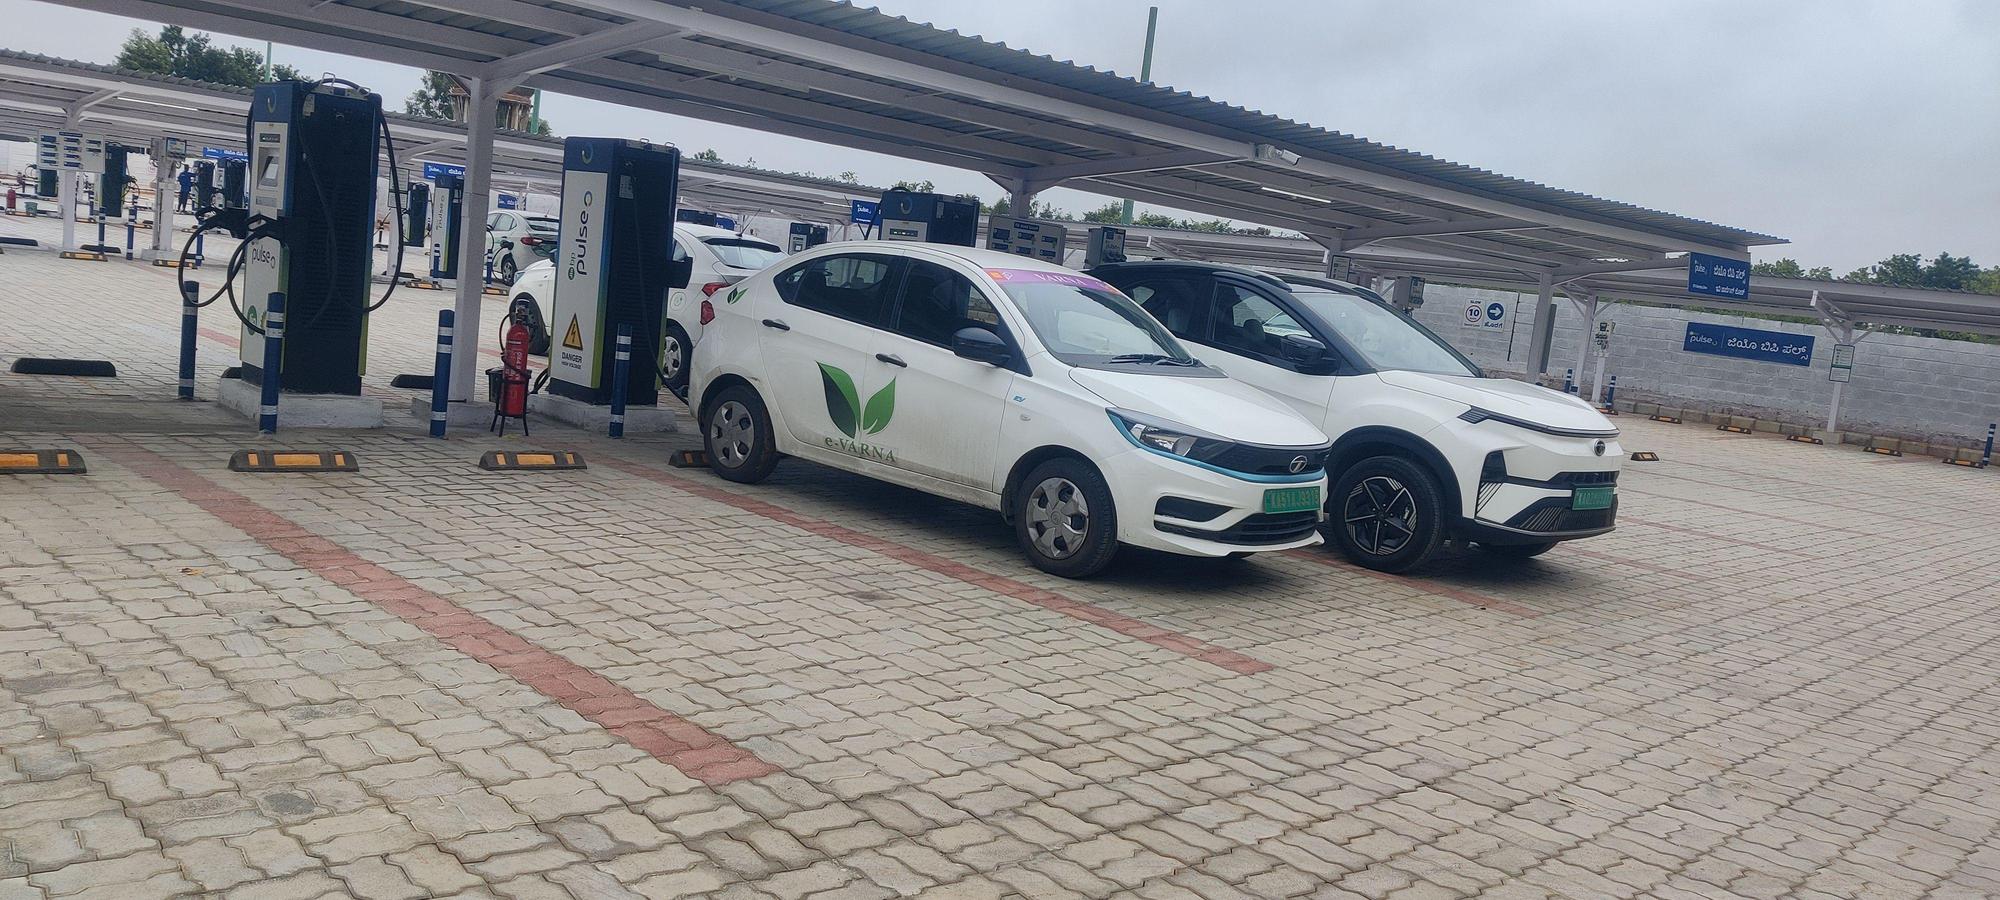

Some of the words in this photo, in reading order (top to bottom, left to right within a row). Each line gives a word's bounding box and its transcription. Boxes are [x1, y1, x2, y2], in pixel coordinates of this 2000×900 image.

[576, 210, 589, 276] pulse
[252, 245, 271, 264] pulse
[1469, 309, 1480, 317] 10
[1690, 335, 1712, 343] pulse
[561, 352, 583, 363] DANGER
[825, 436, 896, 462] e-VARNA
